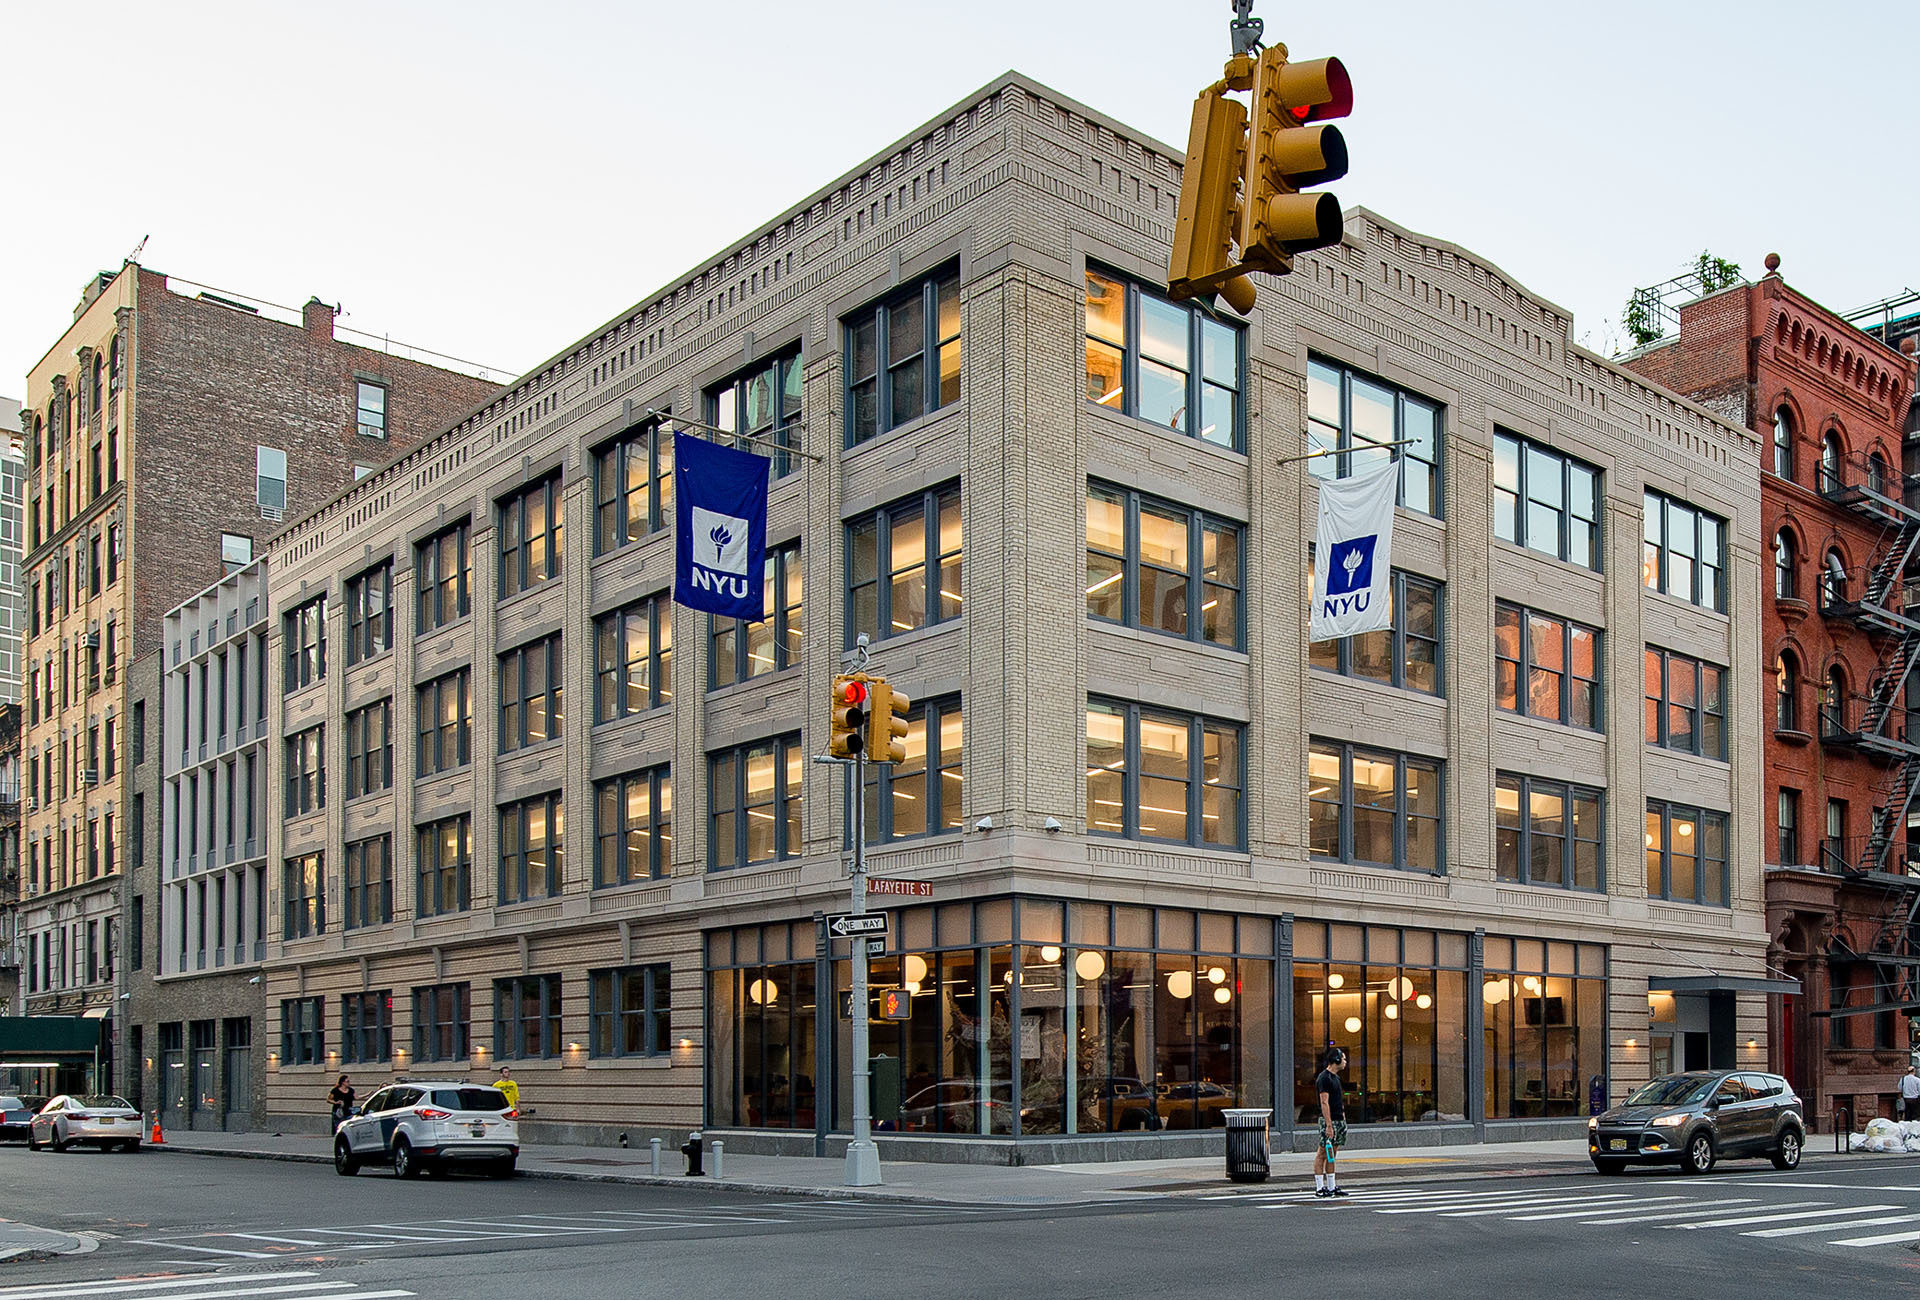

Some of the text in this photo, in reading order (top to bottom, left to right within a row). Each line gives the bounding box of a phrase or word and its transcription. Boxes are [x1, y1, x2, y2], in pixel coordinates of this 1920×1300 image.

[691, 566, 748, 598] NYU
[1323, 591, 1370, 618] NYU
[869, 880, 930, 895] LAFAYETTE ST
[837, 919, 880, 931] ONE WAY
